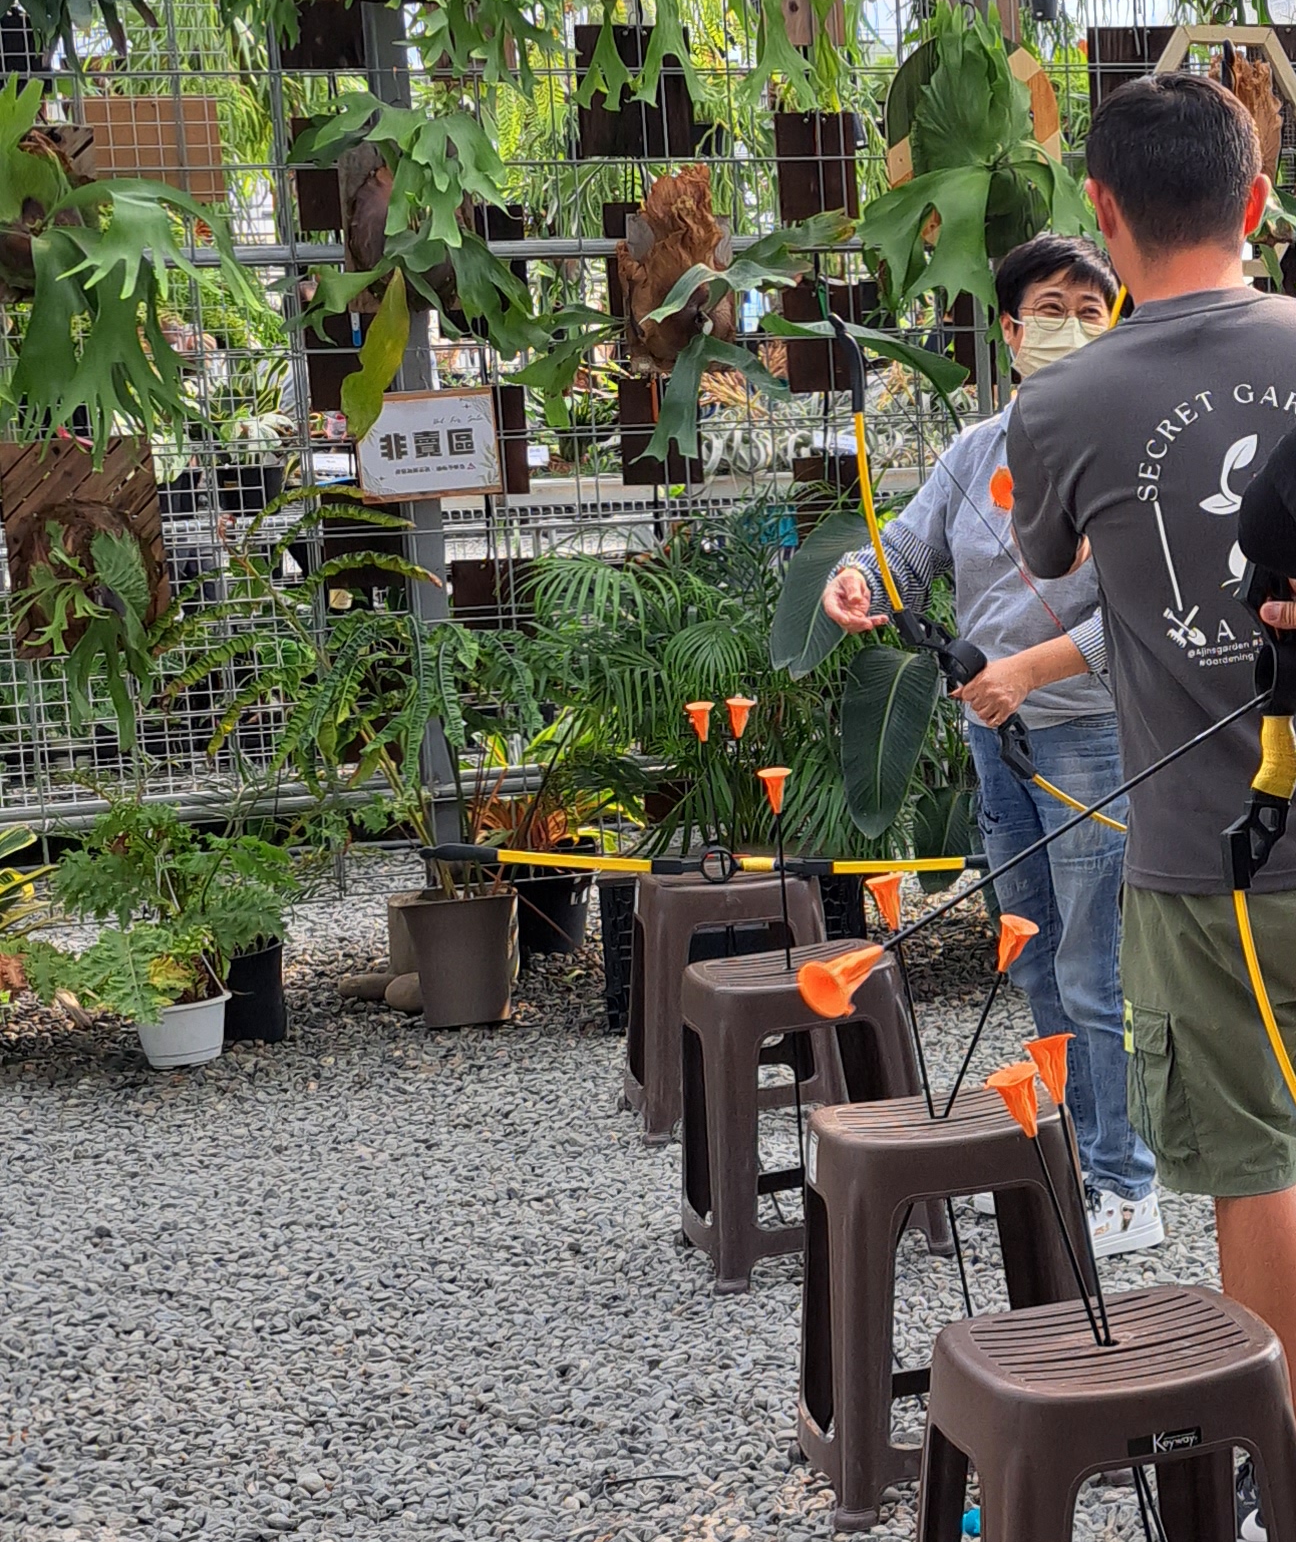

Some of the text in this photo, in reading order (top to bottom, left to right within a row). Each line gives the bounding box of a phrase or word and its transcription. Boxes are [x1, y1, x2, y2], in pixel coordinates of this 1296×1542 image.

[379, 427, 476, 461] 非賣區
[1136, 390, 1214, 502] SECRET
